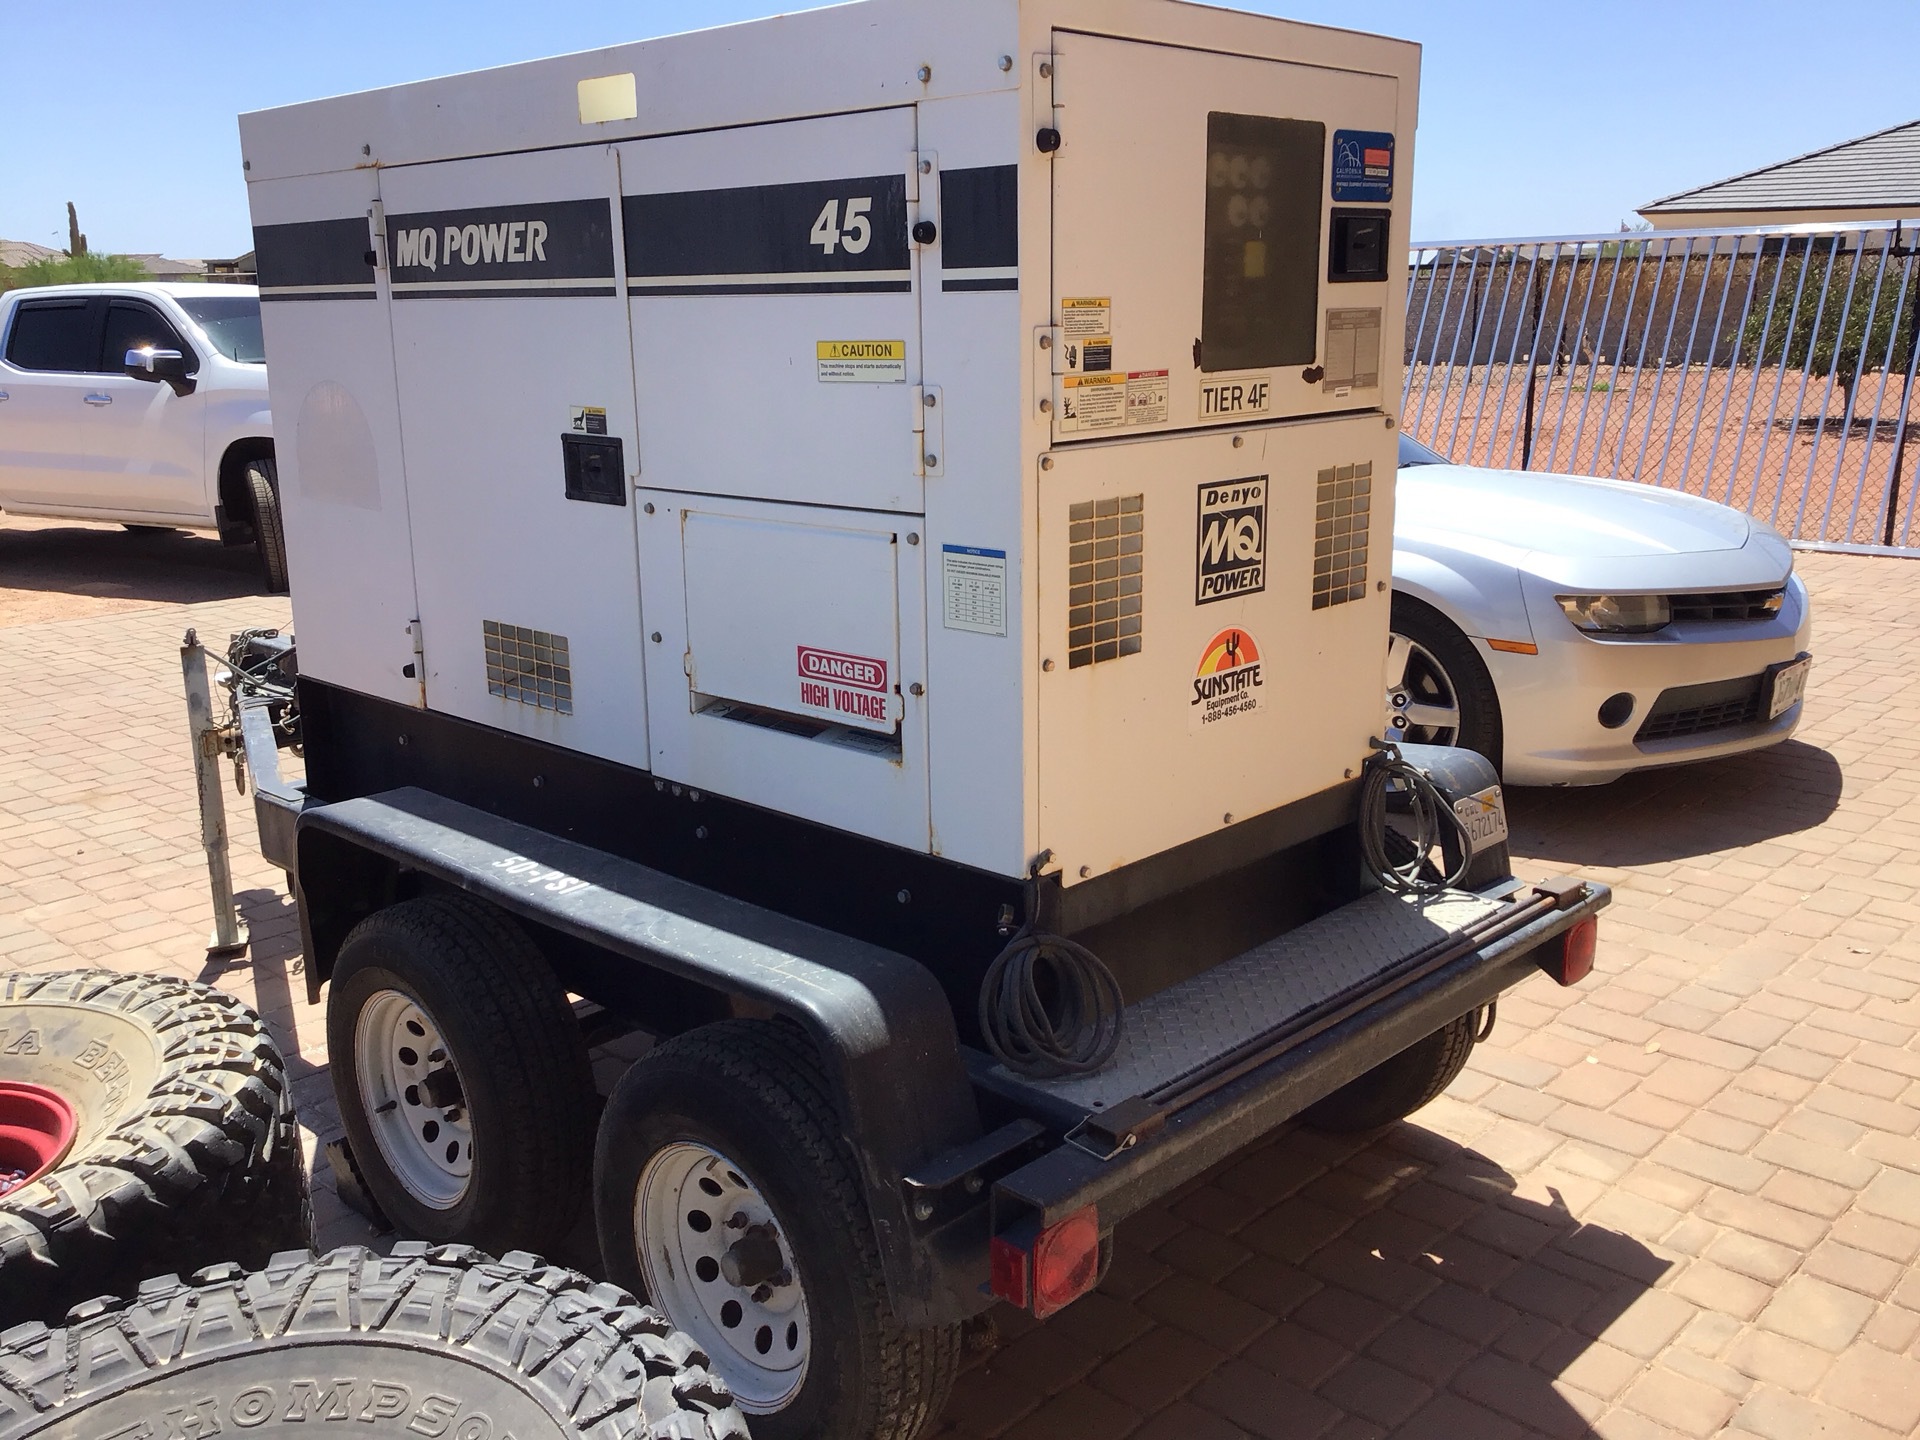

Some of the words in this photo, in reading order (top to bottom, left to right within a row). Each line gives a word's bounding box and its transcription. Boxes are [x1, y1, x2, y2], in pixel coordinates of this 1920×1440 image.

[809, 196, 872, 255] 45
[396, 227, 438, 273] MQ
[443, 220, 548, 266] POWER
[841, 344, 892, 357] CAUTION
[1083, 376, 1111, 385] WARNING
[1203, 385, 1242, 413] TIER
[1247, 383, 1268, 409] 4F
[1205, 486, 1261, 507] Denyo
[1201, 514, 1262, 565] MQ
[1201, 567, 1261, 598] POWER
[808, 655, 876, 683] DANGER
[1190, 664, 1263, 706] SUNSTATE
[800, 682, 830, 709] HIGH
[832, 688, 887, 720] VOLTAGE
[1201, 698, 1257, 724] 1-888-456-4560
[1206, 693, 1240, 711] Equipment
[1240, 690, 1249, 700] Co.
[94, 1378, 518, 1440] HOMPSO
